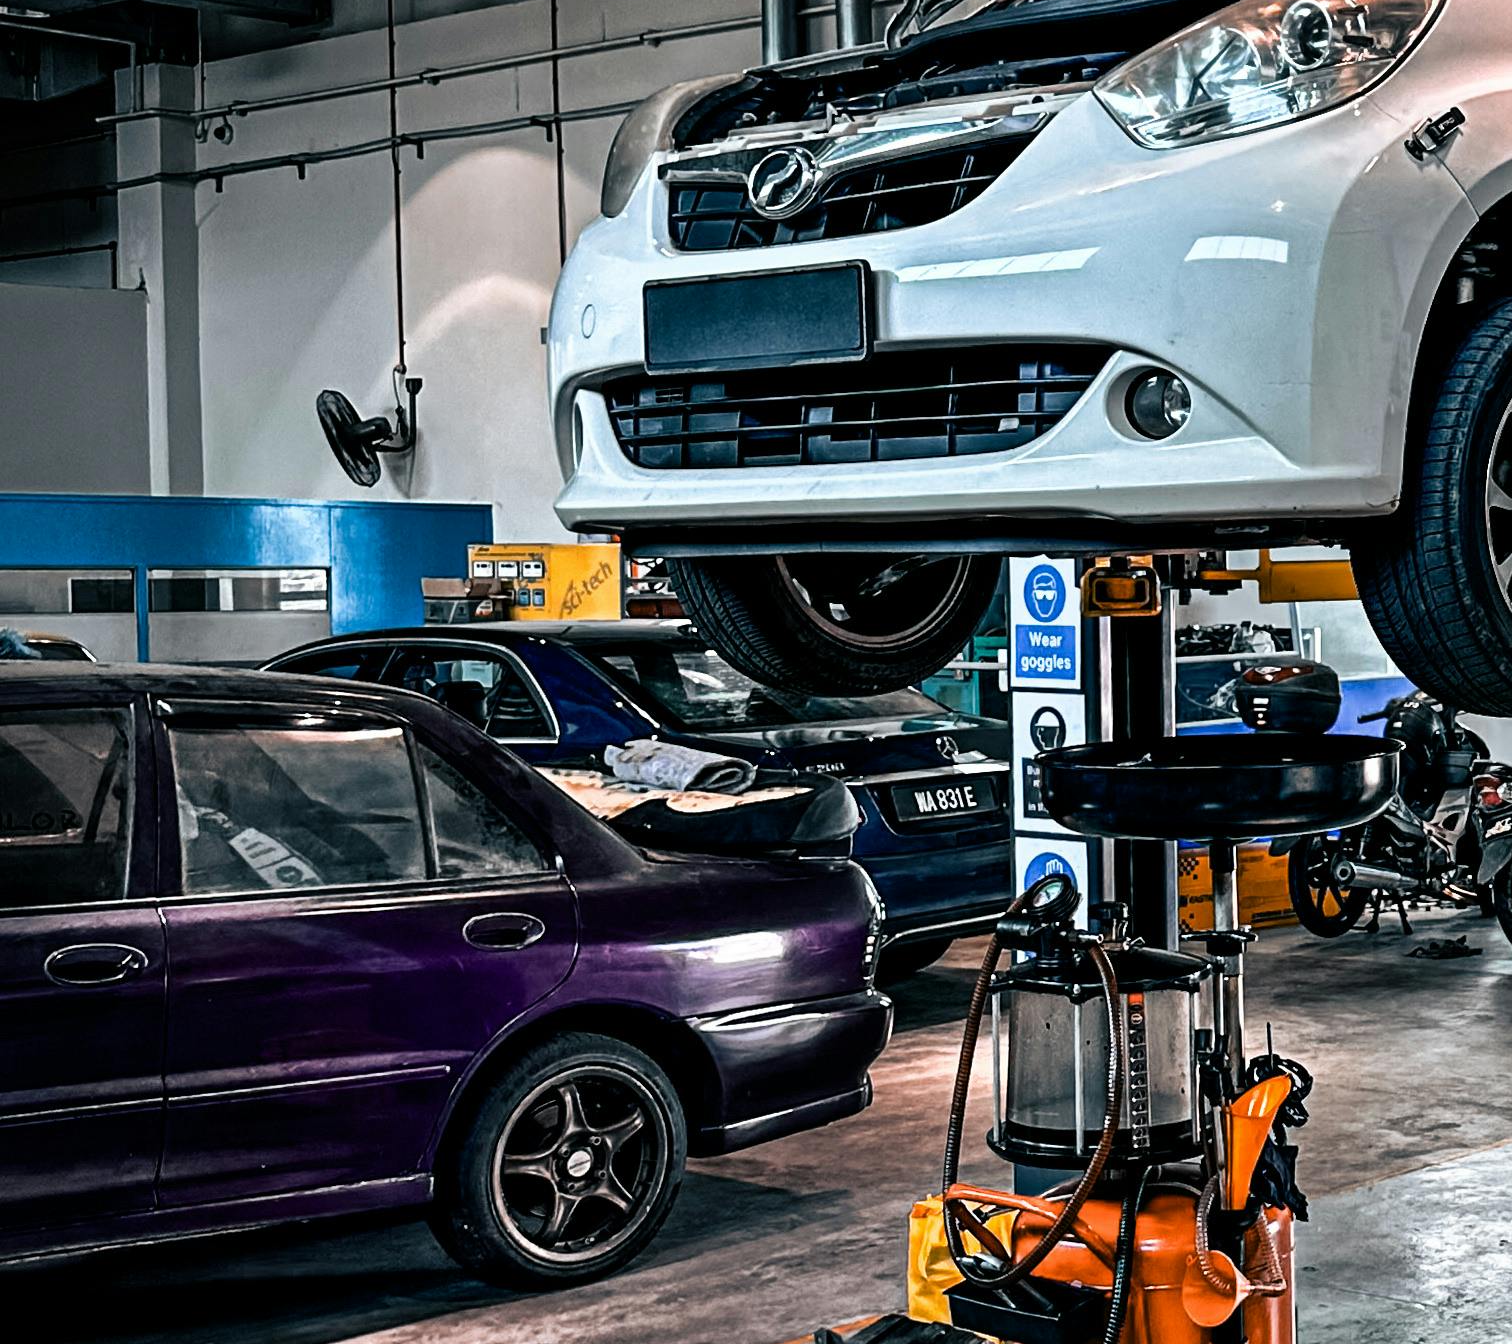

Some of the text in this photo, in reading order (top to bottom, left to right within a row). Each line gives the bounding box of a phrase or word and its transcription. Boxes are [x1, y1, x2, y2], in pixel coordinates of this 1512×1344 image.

[1029, 631, 1062, 648] Wear
[1021, 655, 1071, 673] goggles
[914, 786, 977, 813] WA 831 E
